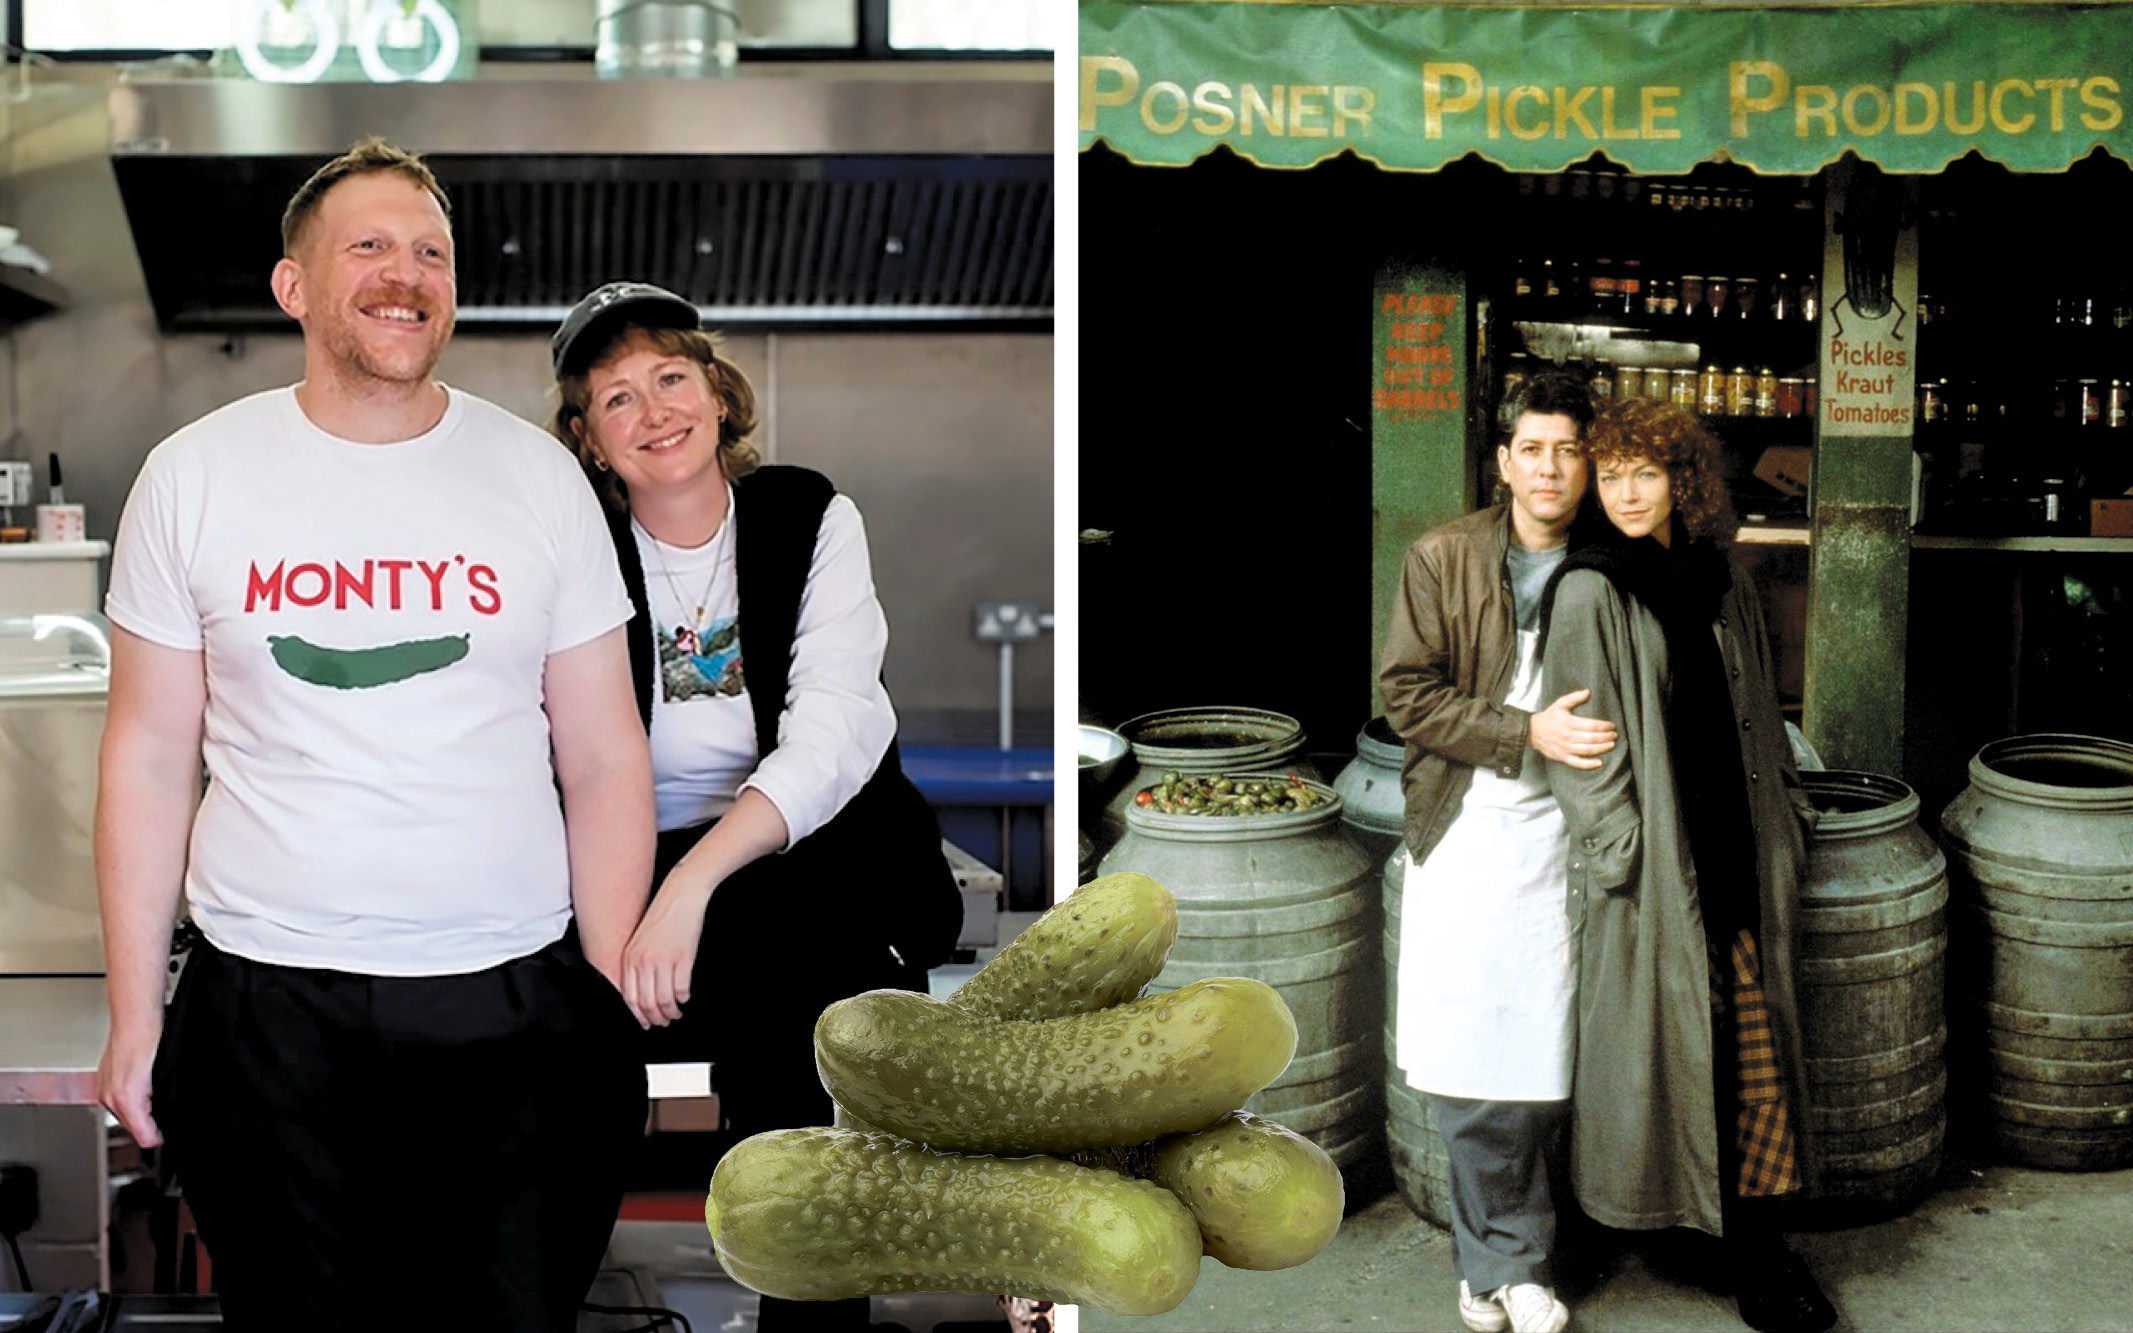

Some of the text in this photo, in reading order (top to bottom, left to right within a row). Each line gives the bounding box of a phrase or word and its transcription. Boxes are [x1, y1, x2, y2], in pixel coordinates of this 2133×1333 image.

[1079, 55, 2123, 141] POSNER PICKLE PRODUCTS
[1392, 322, 1444, 342] KEEP
[1387, 345, 1453, 364] HANDS
[1831, 340, 1907, 366] Pickles
[1384, 368, 1454, 385] OUT OF
[1836, 371, 1894, 395] Kraut
[1375, 389, 1460, 410] BARRELS
[1824, 398, 1910, 424] Tomatoes
[244, 554, 501, 615] MONTY'S
